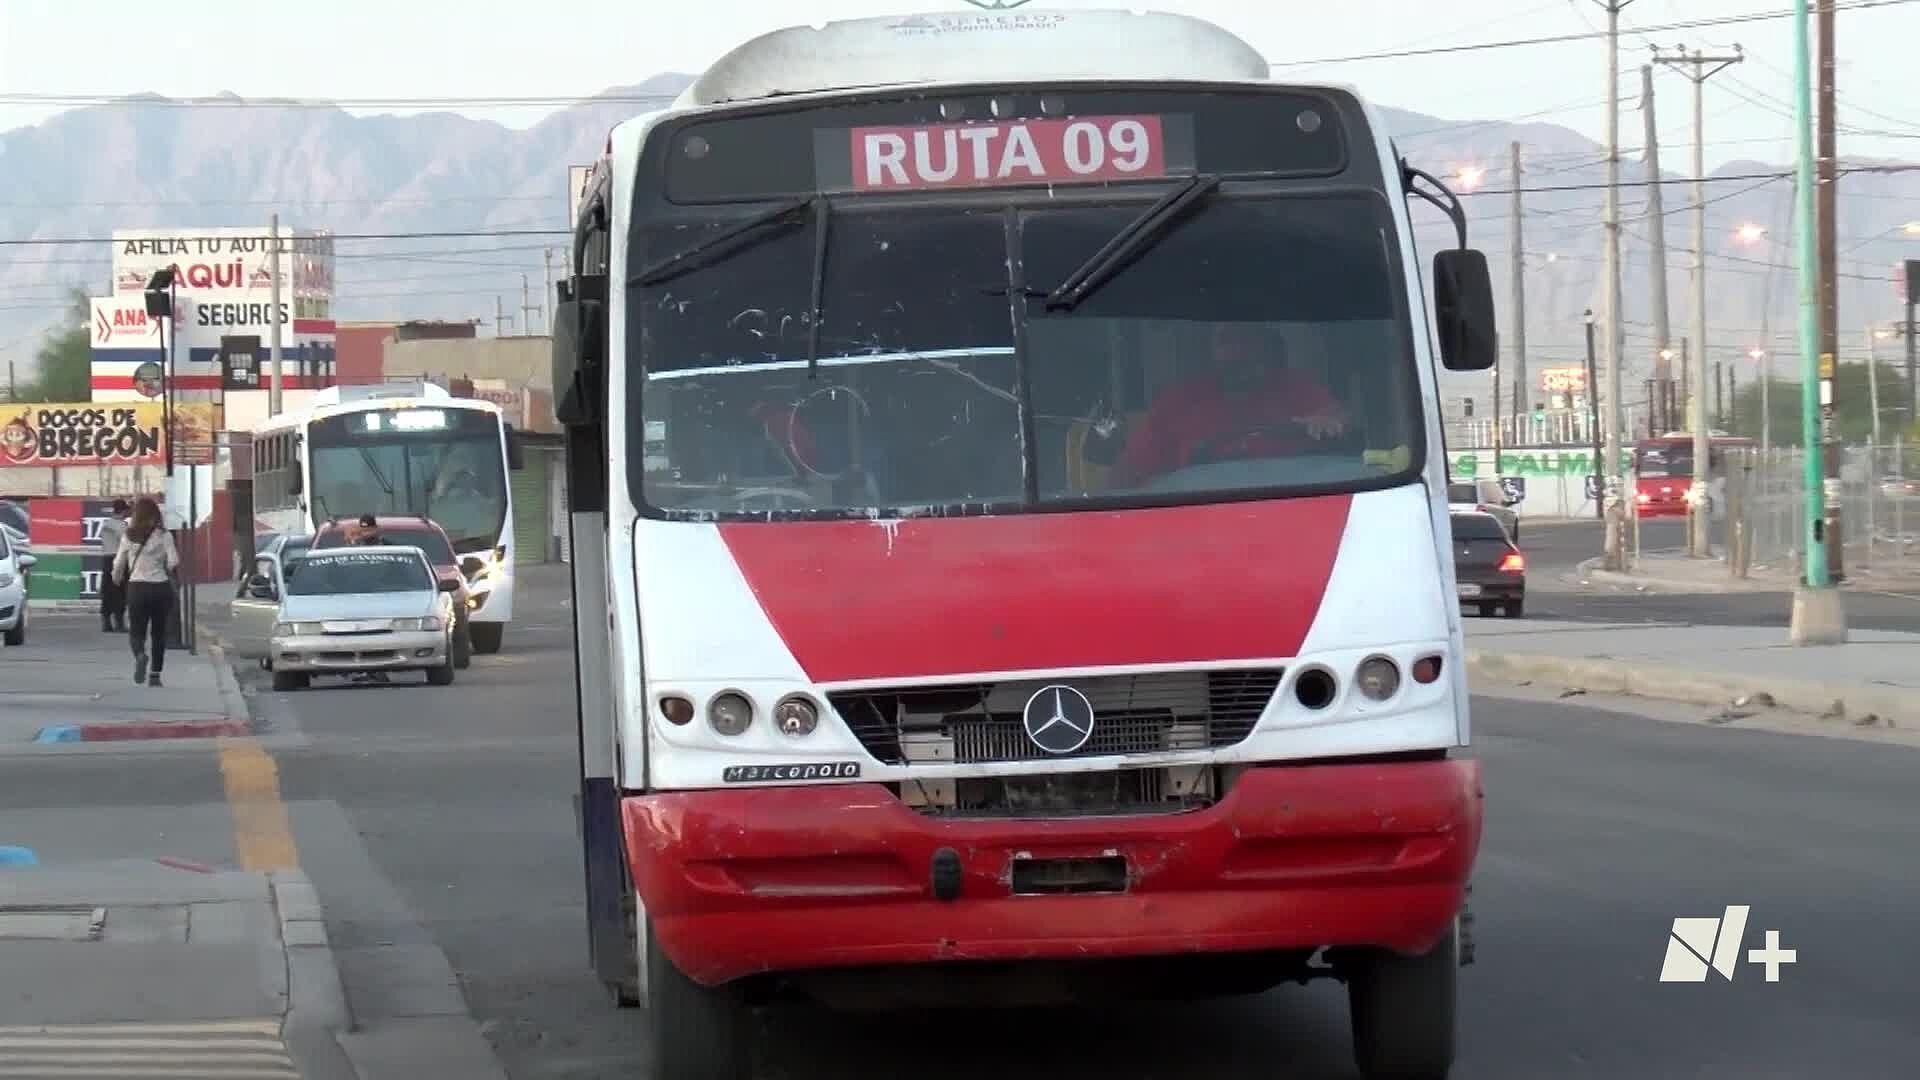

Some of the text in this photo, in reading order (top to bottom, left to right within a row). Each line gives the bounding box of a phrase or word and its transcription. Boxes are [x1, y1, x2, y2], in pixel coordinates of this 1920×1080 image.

[864, 120, 1150, 186] RUTA 09
[124, 239, 189, 254] AFILIA
[197, 238, 221, 254] TU
[113, 309, 147, 326] ANA
[38, 409, 136, 427] DOGOS DE
